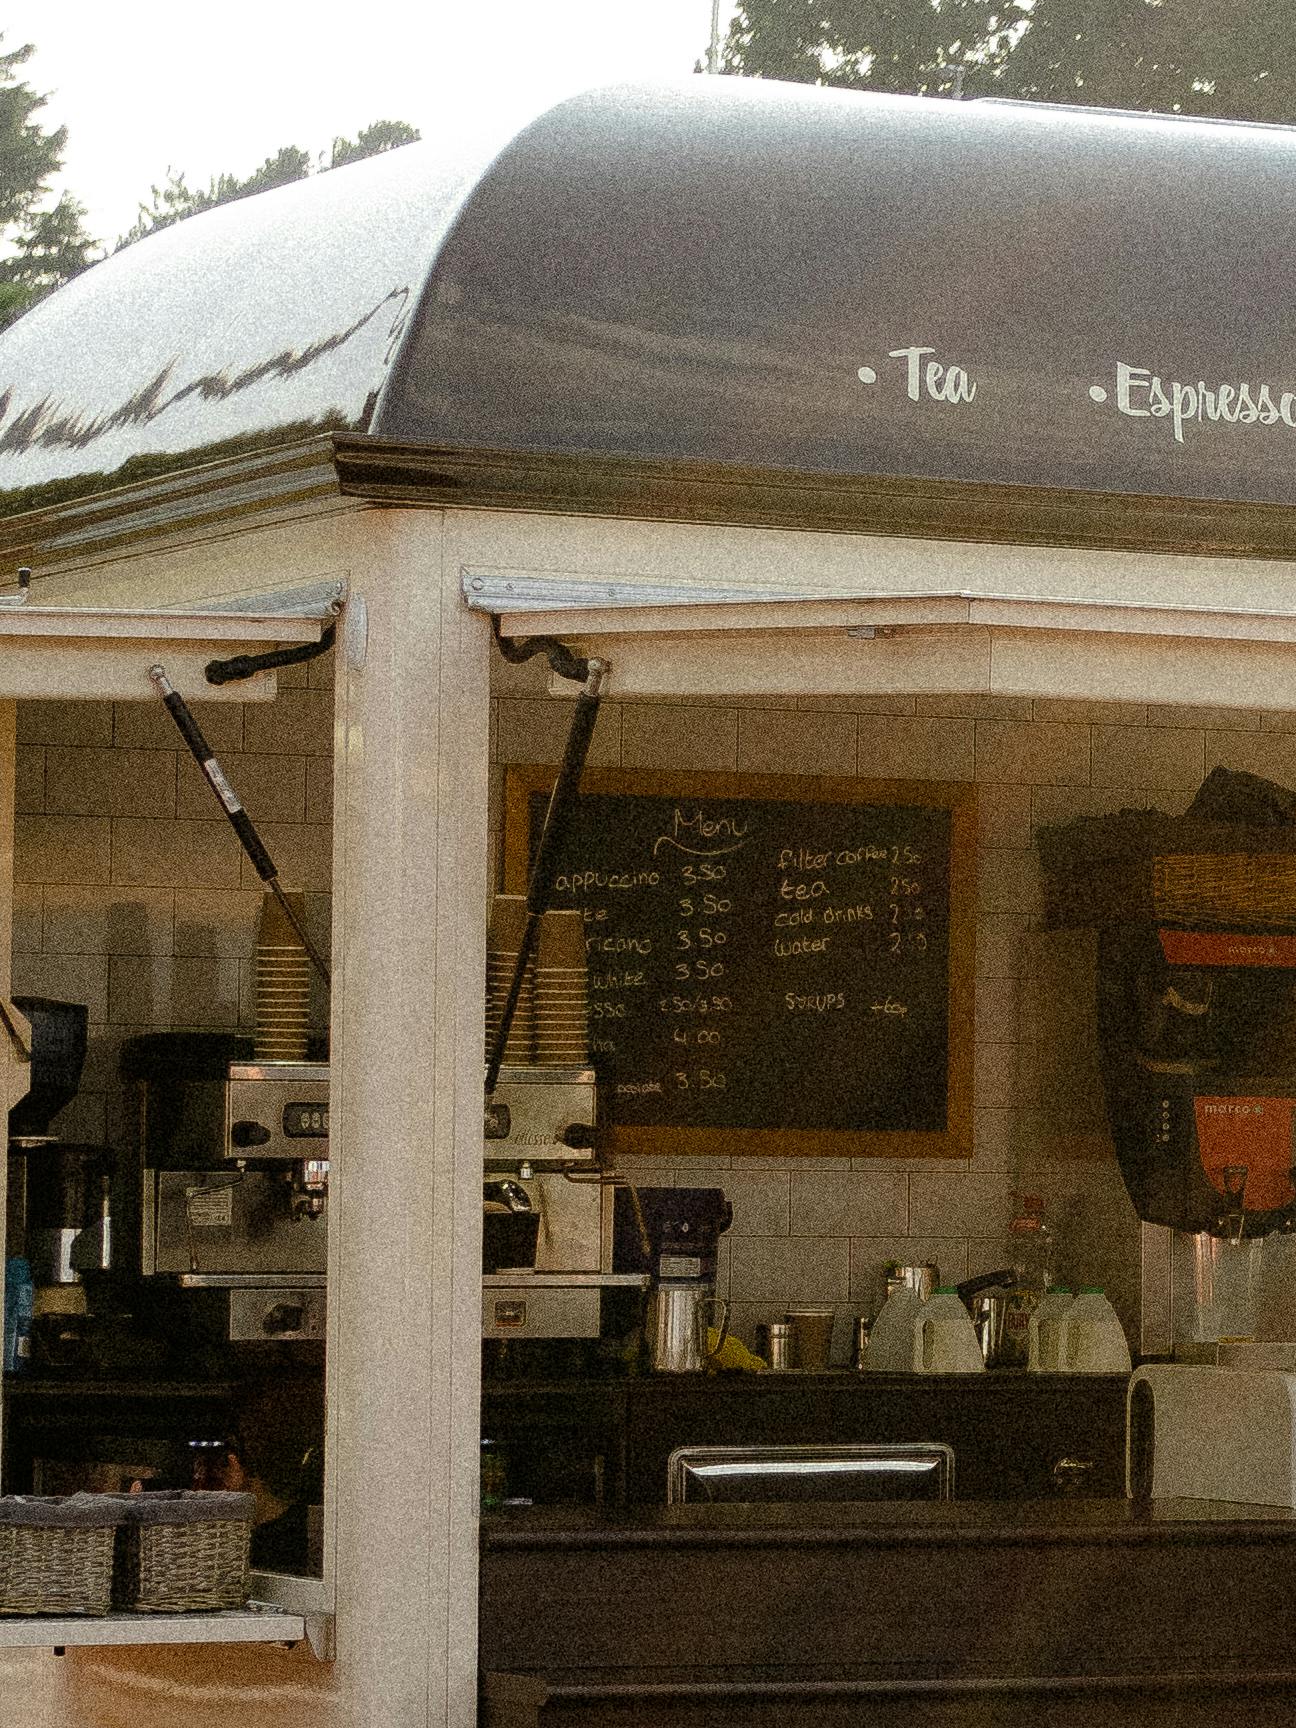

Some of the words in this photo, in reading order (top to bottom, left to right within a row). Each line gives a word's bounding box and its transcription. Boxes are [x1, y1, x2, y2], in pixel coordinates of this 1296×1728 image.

[889, 345, 977, 404] Tea
[674, 808, 748, 839] Menu
[777, 847, 833, 870] filter
[555, 871, 660, 893] appuccino
[779, 877, 830, 902] tea
[583, 907, 609, 922] te
[773, 908, 814, 928] cold
[823, 904, 874, 926] drinks
[585, 936, 653, 955] ricano
[774, 936, 831, 958] water
[593, 1002, 625, 1020] sso
[1203, 1104, 1250, 1114] marco
